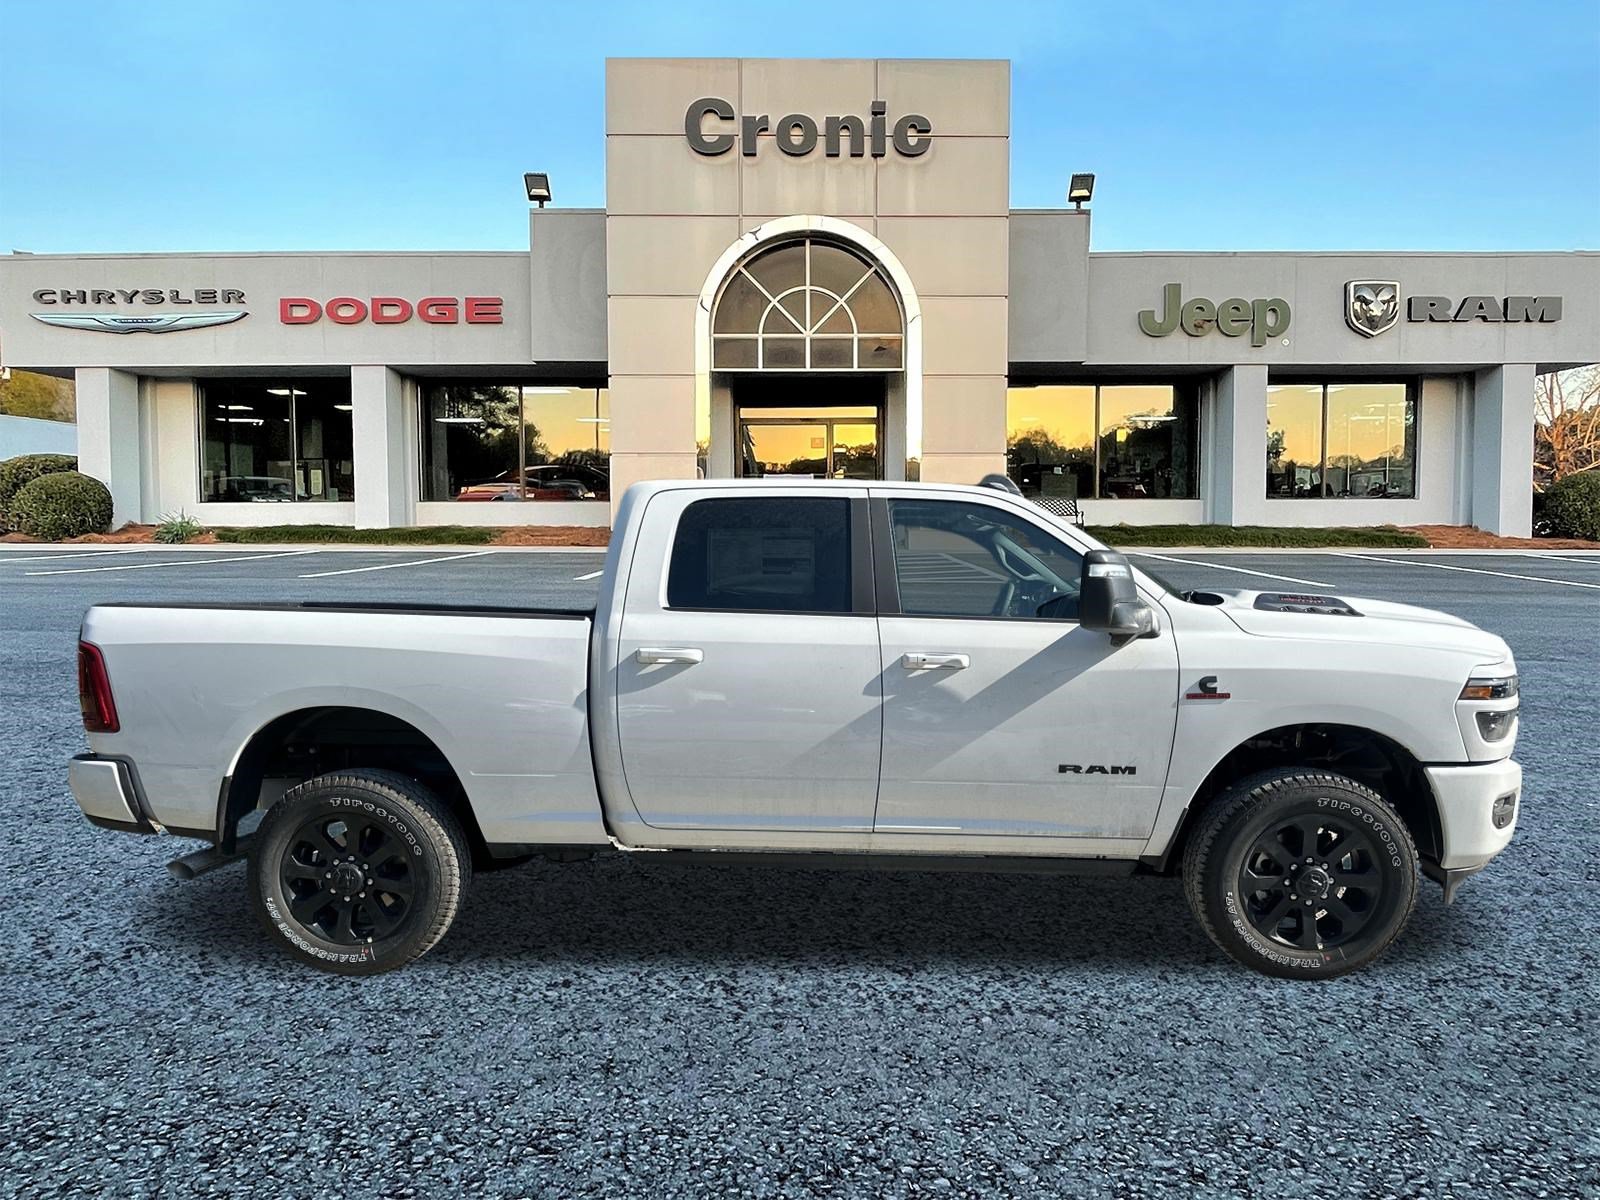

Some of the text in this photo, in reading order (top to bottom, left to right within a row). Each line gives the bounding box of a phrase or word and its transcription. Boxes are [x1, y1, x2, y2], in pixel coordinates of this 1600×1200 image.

[684, 97, 932, 157] Cronic
[32, 289, 247, 305] CHRYSLER
[280, 296, 504, 325] DODGE
[1408, 296, 1562, 322] RAM
[1138, 283, 1291, 347] Jeep
[1058, 764, 1137, 775] RAM
[278, 922, 368, 963] TRANSFORCE
[1233, 919, 1321, 968] TRANSFORCE
